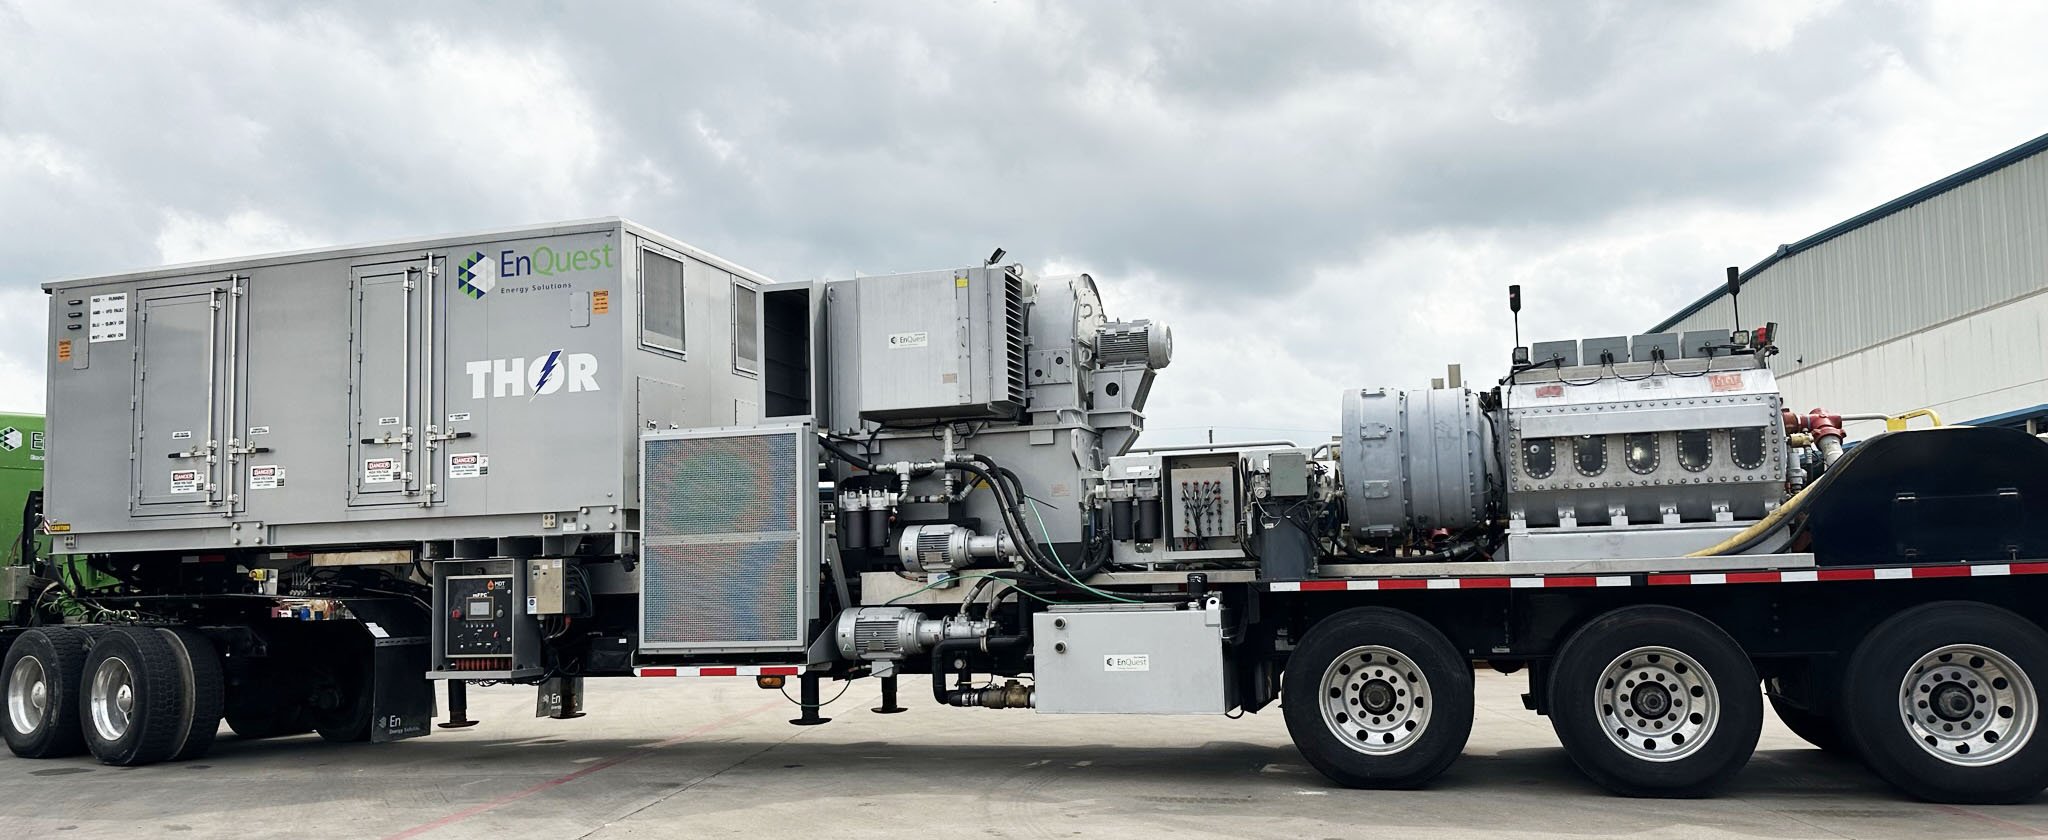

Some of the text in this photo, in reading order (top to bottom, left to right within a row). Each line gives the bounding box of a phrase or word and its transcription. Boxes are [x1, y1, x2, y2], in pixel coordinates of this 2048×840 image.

[501, 244, 614, 277] EnQuest
[532, 282, 572, 291] Solutions
[466, 352, 600, 399] THOR
[452, 456, 476, 464] DANGER
[174, 472, 194, 480] DANGER
[253, 468, 274, 476] DANGER
[1117, 658, 1147, 666] EnQuest
